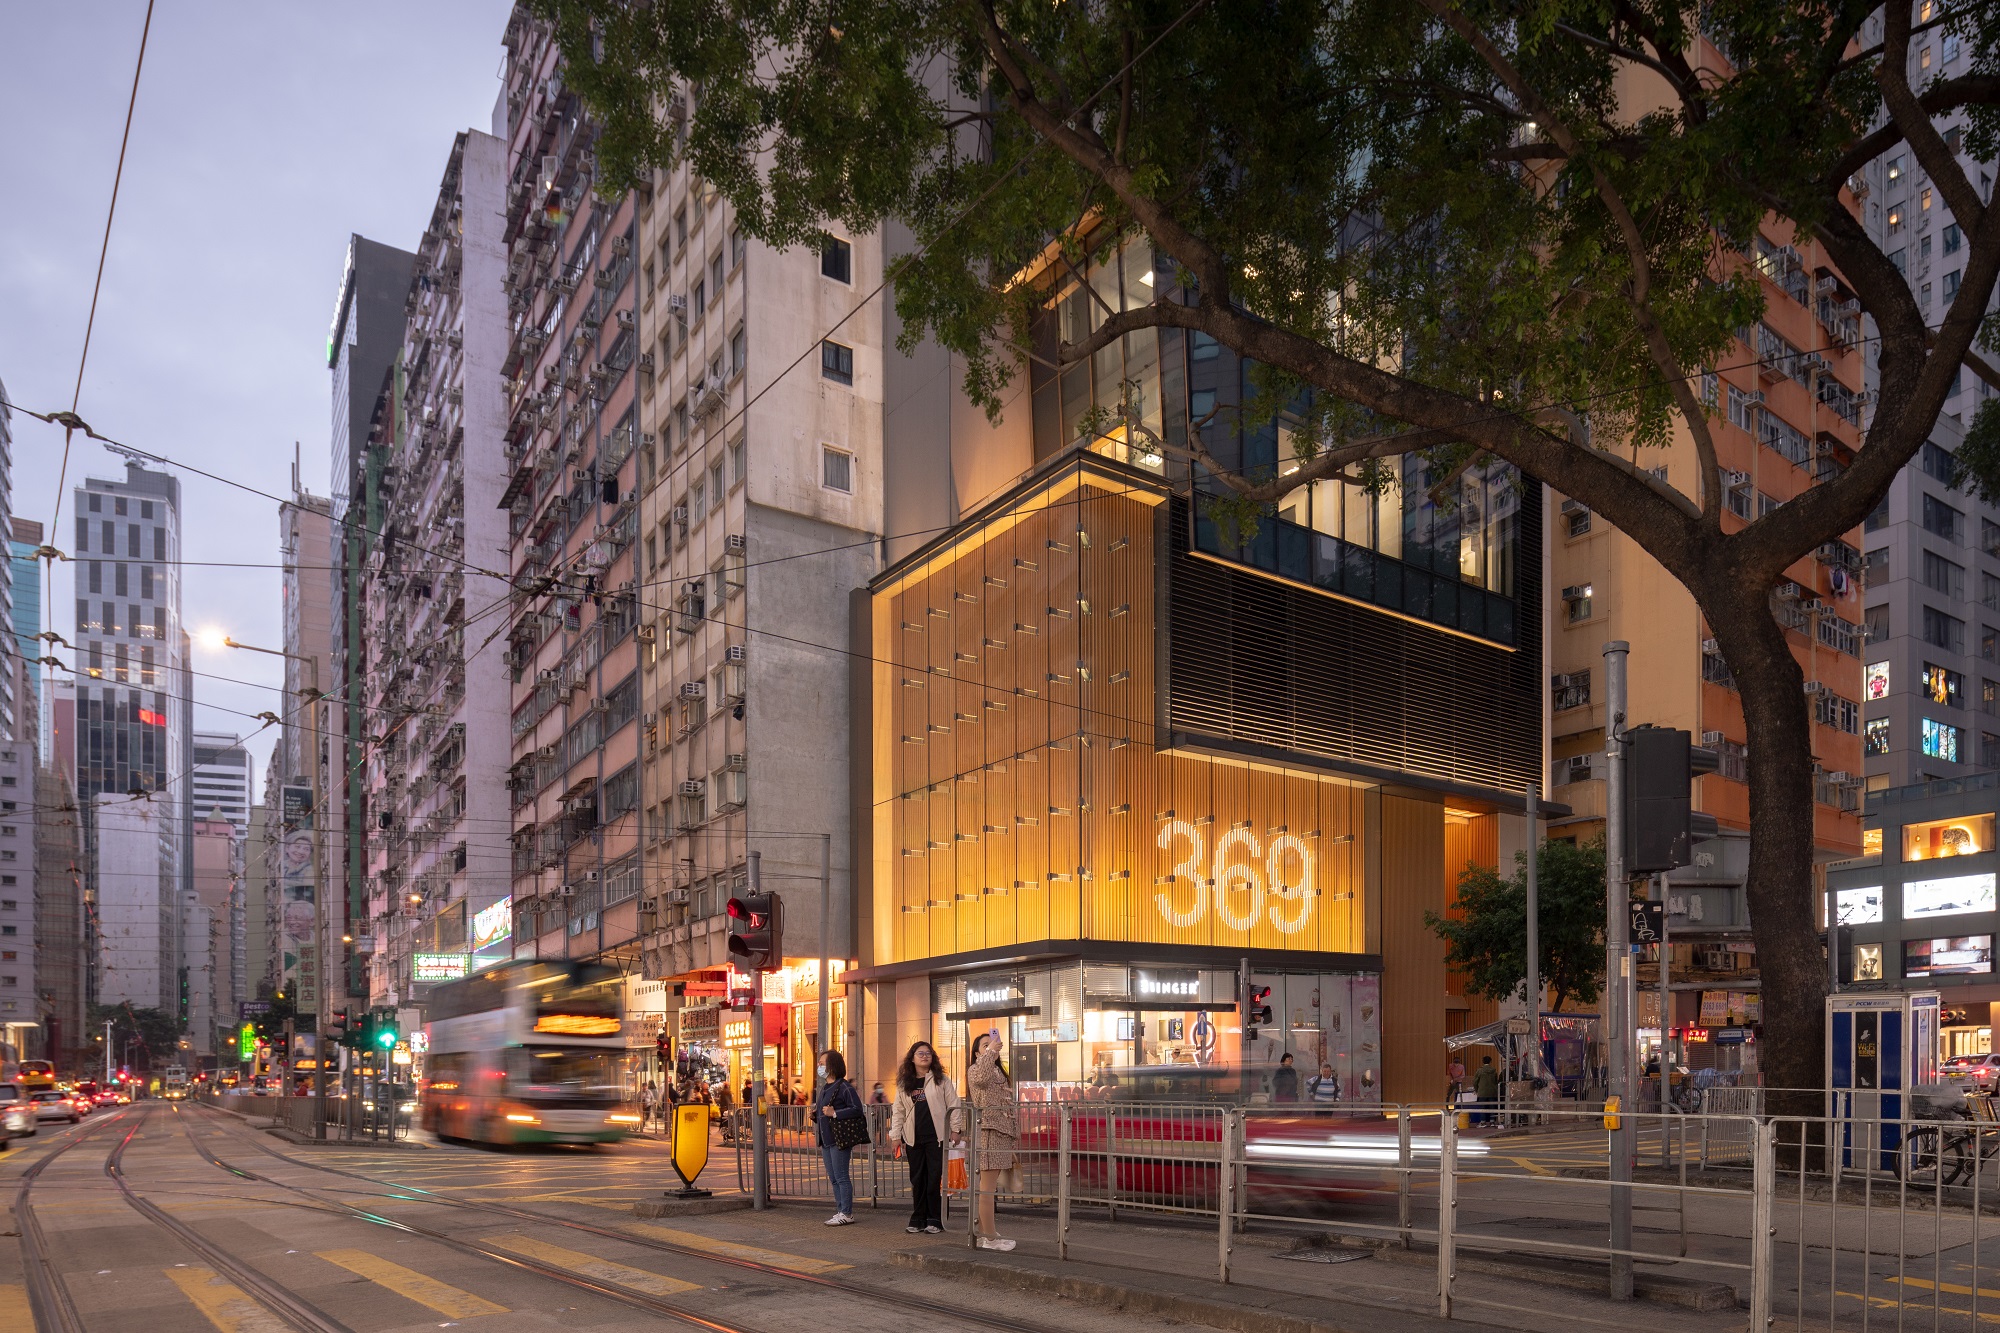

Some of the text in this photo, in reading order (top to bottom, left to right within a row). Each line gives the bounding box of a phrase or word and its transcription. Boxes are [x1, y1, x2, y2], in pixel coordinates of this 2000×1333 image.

[1155, 821, 1312, 934] 369
[300, 946, 315, 1001] 新都酒店
